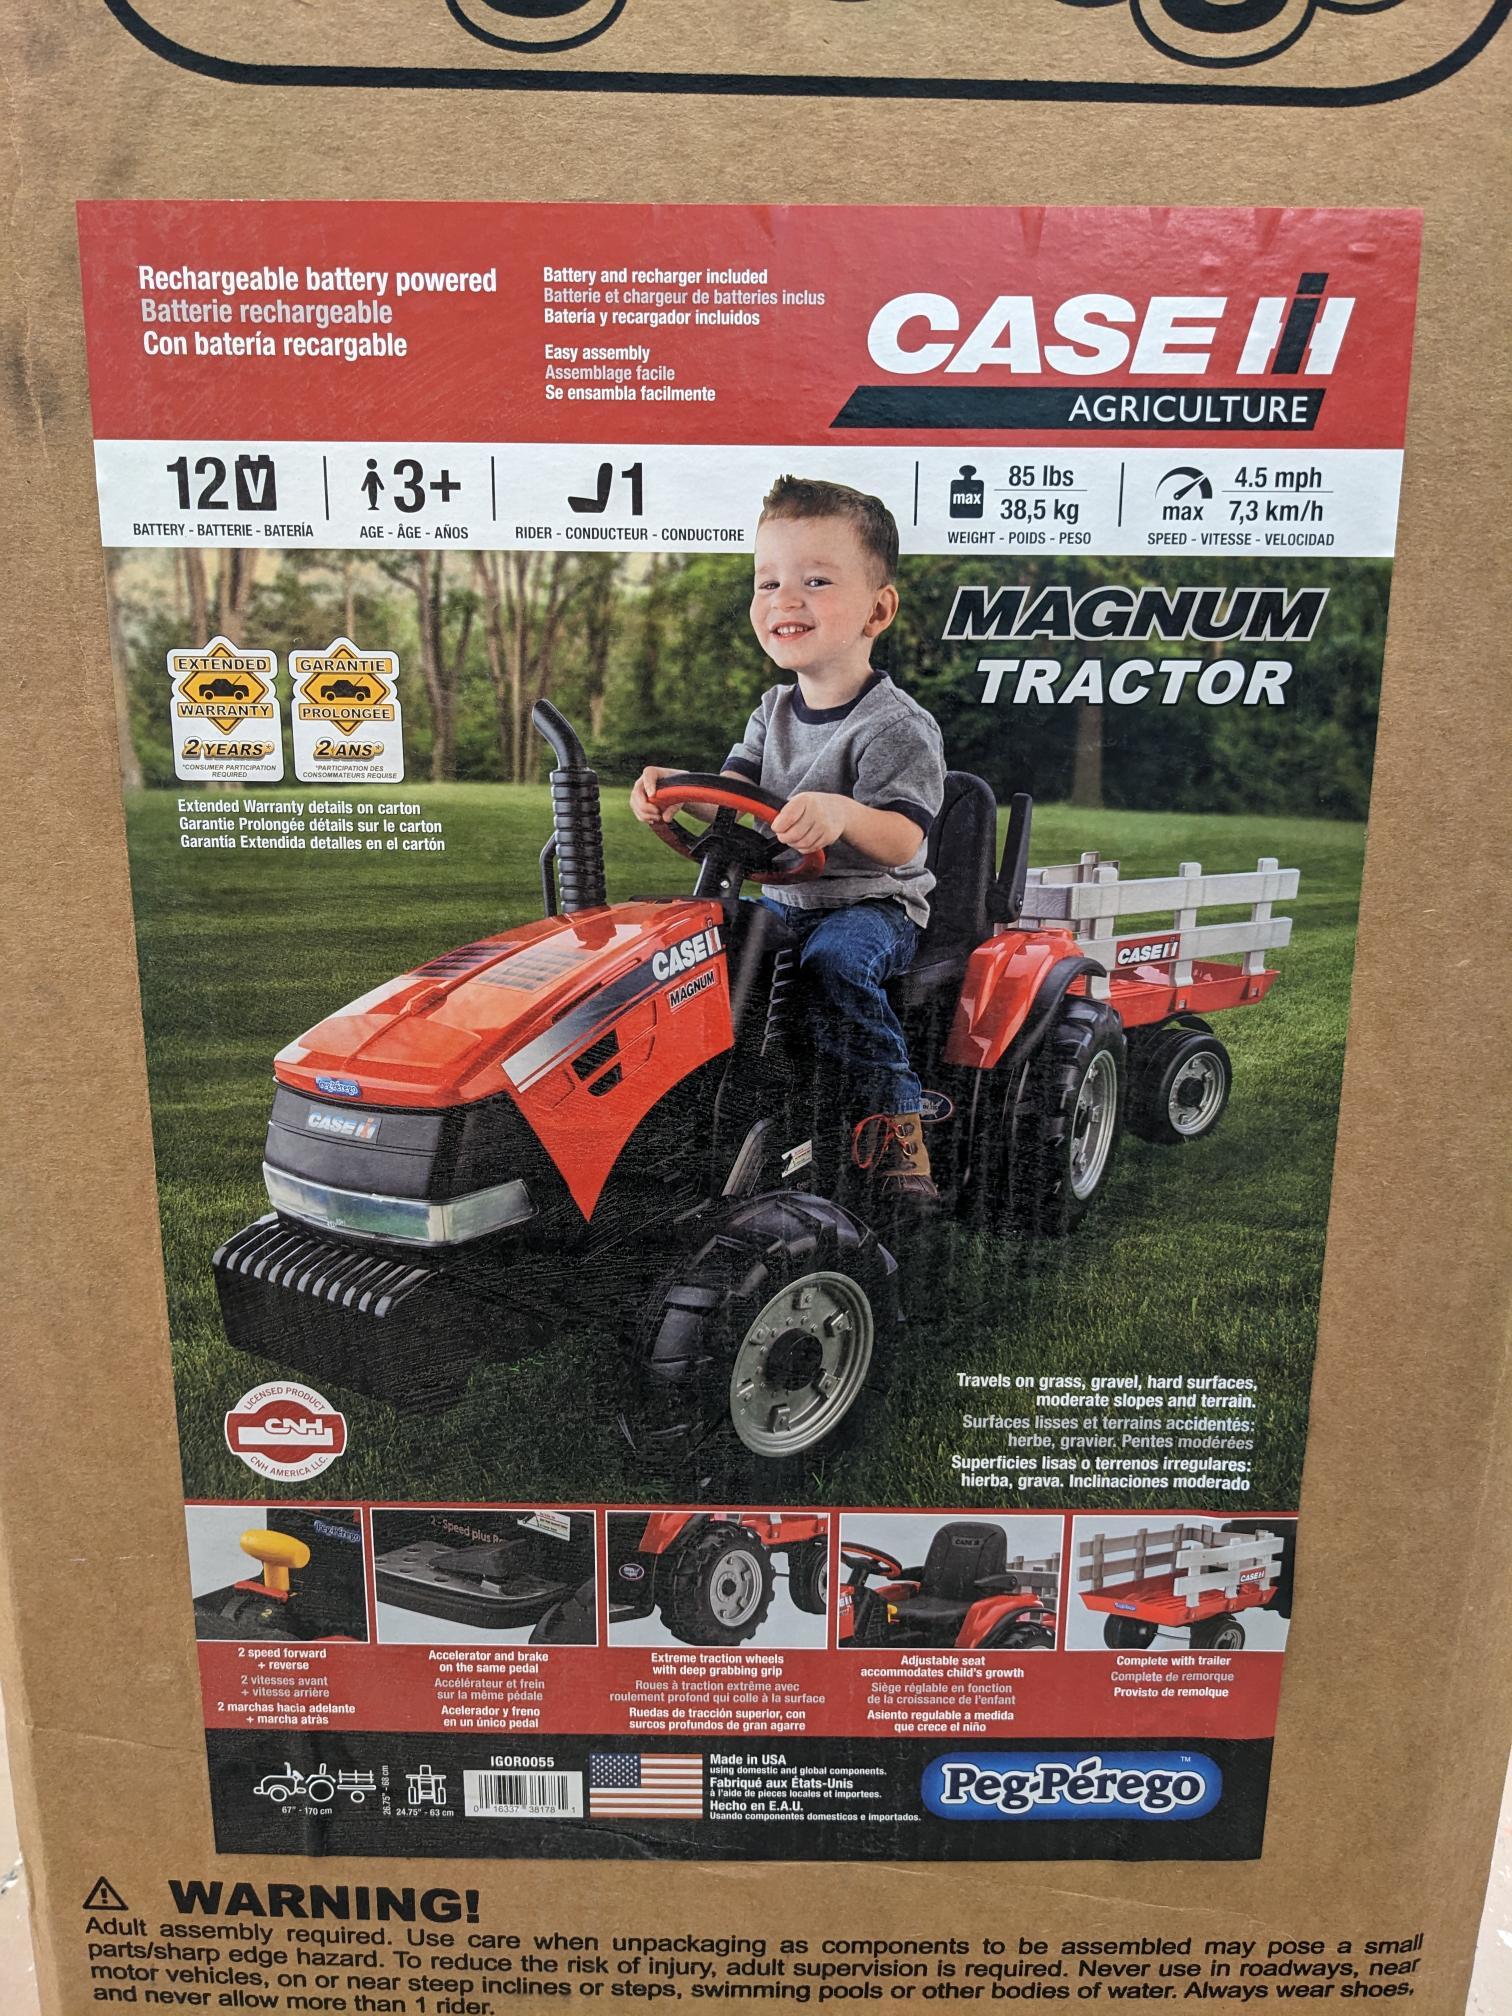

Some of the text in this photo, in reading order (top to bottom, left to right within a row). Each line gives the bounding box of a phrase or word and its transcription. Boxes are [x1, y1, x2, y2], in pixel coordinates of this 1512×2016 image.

[138, 265, 496, 296] Rechargeable battery powered
[543, 266, 768, 287] Battery and recharger included
[141, 298, 392, 327] Batterie rechargeable
[867, 292, 1228, 377] CASE
[143, 330, 407, 361] Con batería recargable
[544, 344, 650, 363] Easy assembly
[545, 384, 716, 401] Se ensambla facilmente
[1067, 395, 1308, 424] AGRICULTURE
[1008, 464, 1074, 486] 85 lbs
[1234, 466, 1322, 490] 4.5 mph
[953, 490, 981, 505] max
[1000, 498, 1079, 525] 38,5 kg
[1162, 504, 1203, 521] max
[1228, 499, 1323, 525] 7,3 km/h
[132, 521, 314, 537] BATTERY BATTERIE BATERÍA
[359, 523, 468, 539] AGE ÂGE AÑOS
[515, 526, 744, 541] RIDER CONDUCTEUR CONDUCTORE
[947, 531, 1091, 544] WEIGHT POIDS PESO
[1147, 532, 1334, 546] SPEED VITESSE VELOCIDAD
[941, 585, 1330, 642] MAGNUM
[177, 657, 267, 672] EXTENDED
[300, 659, 386, 673] GARANTIE
[976, 658, 1293, 706] TRACTOR
[180, 703, 270, 717] WARRANTY
[177, 798, 420, 816] Extended Warranty details on carton
[652, 933, 708, 981] CASE
[1117, 944, 1164, 965] CASE
[667, 968, 715, 1009] MAGNUM
[308, 1111, 357, 1136] CASE
[956, 1372, 1257, 1392] Travels on grass, gravel, hard surfaces,
[244, 1386, 326, 1411] LICENSED PRODUCT
[1036, 1394, 1256, 1409] moderate slopes and terrain.
[250, 1456, 269, 1472] CNH
[270, 1466, 312, 1477] AMERICA
[247, 1647, 280, 1660] speed
[283, 1647, 326, 1658] forward
[428, 1649, 550, 1663] Accelerator and brake
[651, 1652, 784, 1668] Extreme traction wheels
[900, 1655, 986, 1670] Adjustable seat
[1116, 1655, 1232, 1668] Complete with trailer
[268, 1661, 309, 1670] reverse
[439, 1662, 538, 1675] on the same pedal
[652, 1664, 782, 1679] with deep grabbing grip
[860, 1666, 944, 1677] accommodates
[985, 1667, 1024, 1680] growth
[709, 1754, 786, 1766] Made in USA
[168, 1879, 479, 1924] WARNING!
[85, 1916, 1424, 1961] Adult assembly required. Use care when unpackaging as components to be assembled may pose a small
[93, 1985, 137, 2002] and
[144, 1989, 212, 2005] never
[218, 1989, 279, 2008] allow
[286, 1996, 347, 2011] more
[353, 1994, 406, 2013] than
[436, 1997, 495, 2016] rider.
